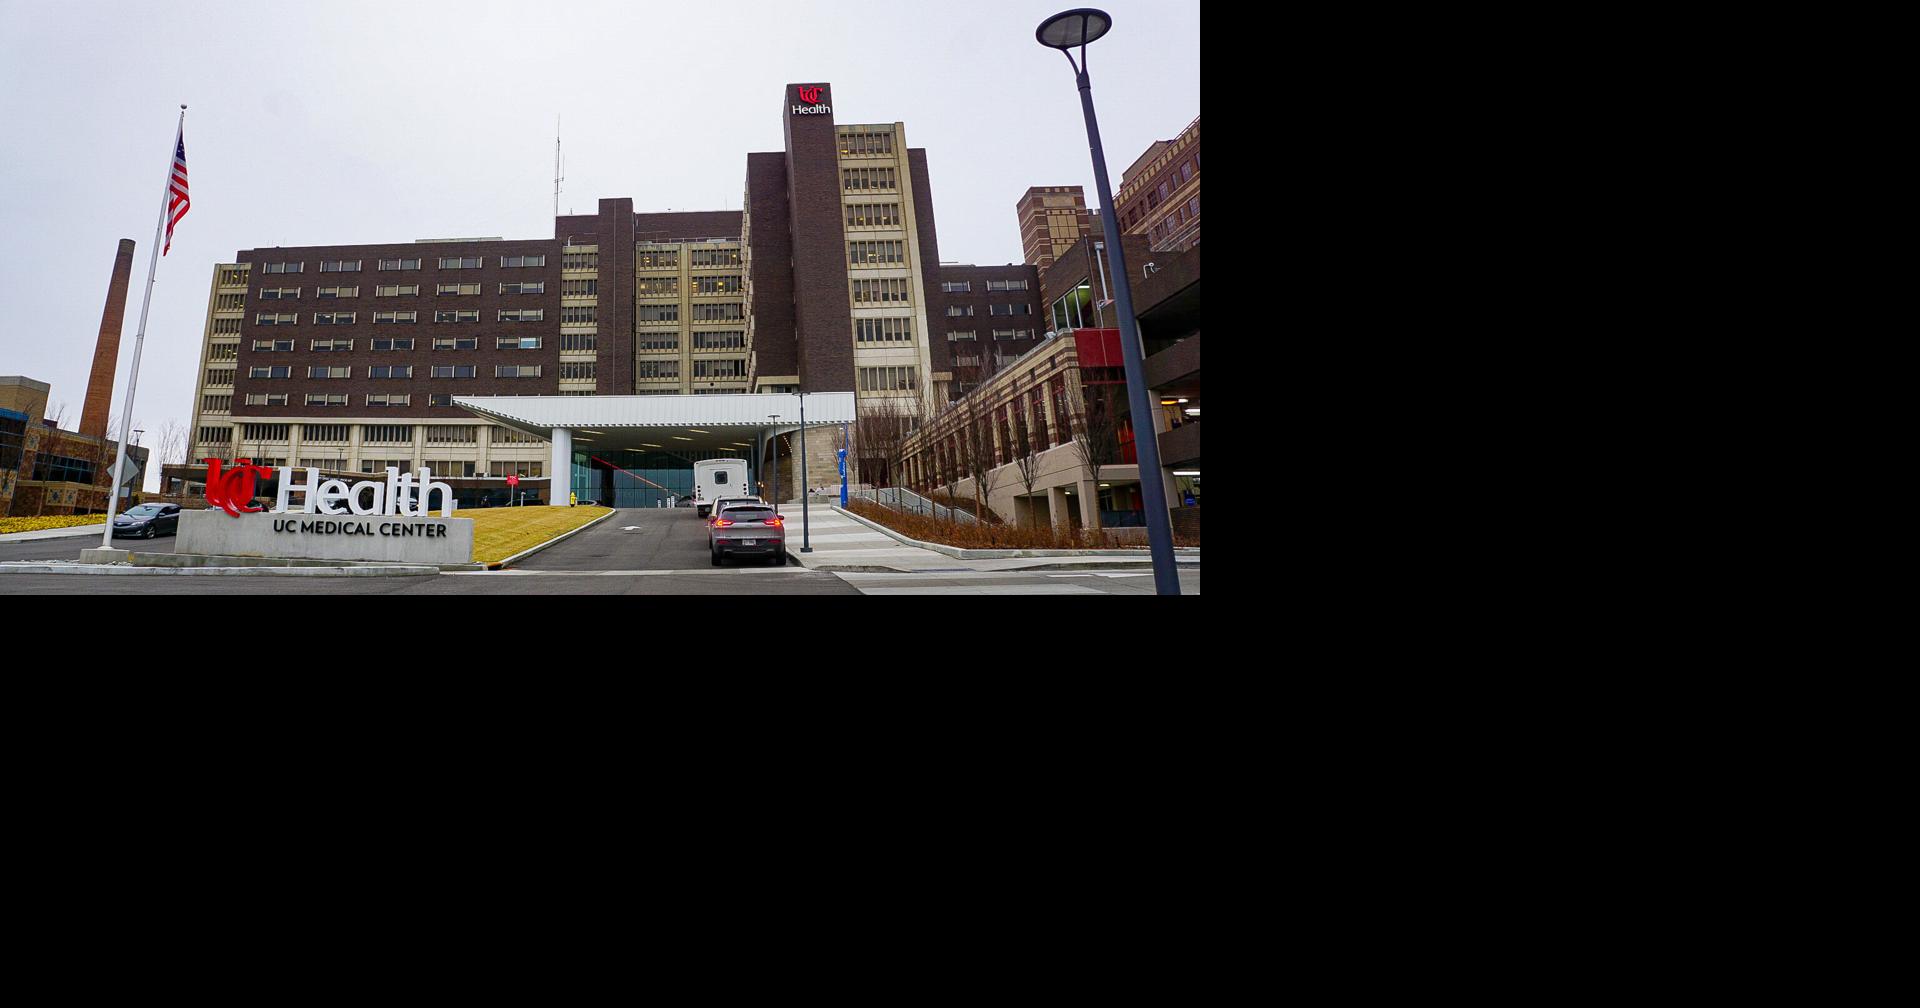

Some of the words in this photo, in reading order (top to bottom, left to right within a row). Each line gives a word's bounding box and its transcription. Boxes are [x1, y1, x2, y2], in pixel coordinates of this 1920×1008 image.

[792, 104, 831, 114] Health
[275, 466, 453, 518] Health
[273, 519, 297, 533] UC
[300, 520, 375, 536] MEDICAL
[379, 522, 447, 538] CENTER
